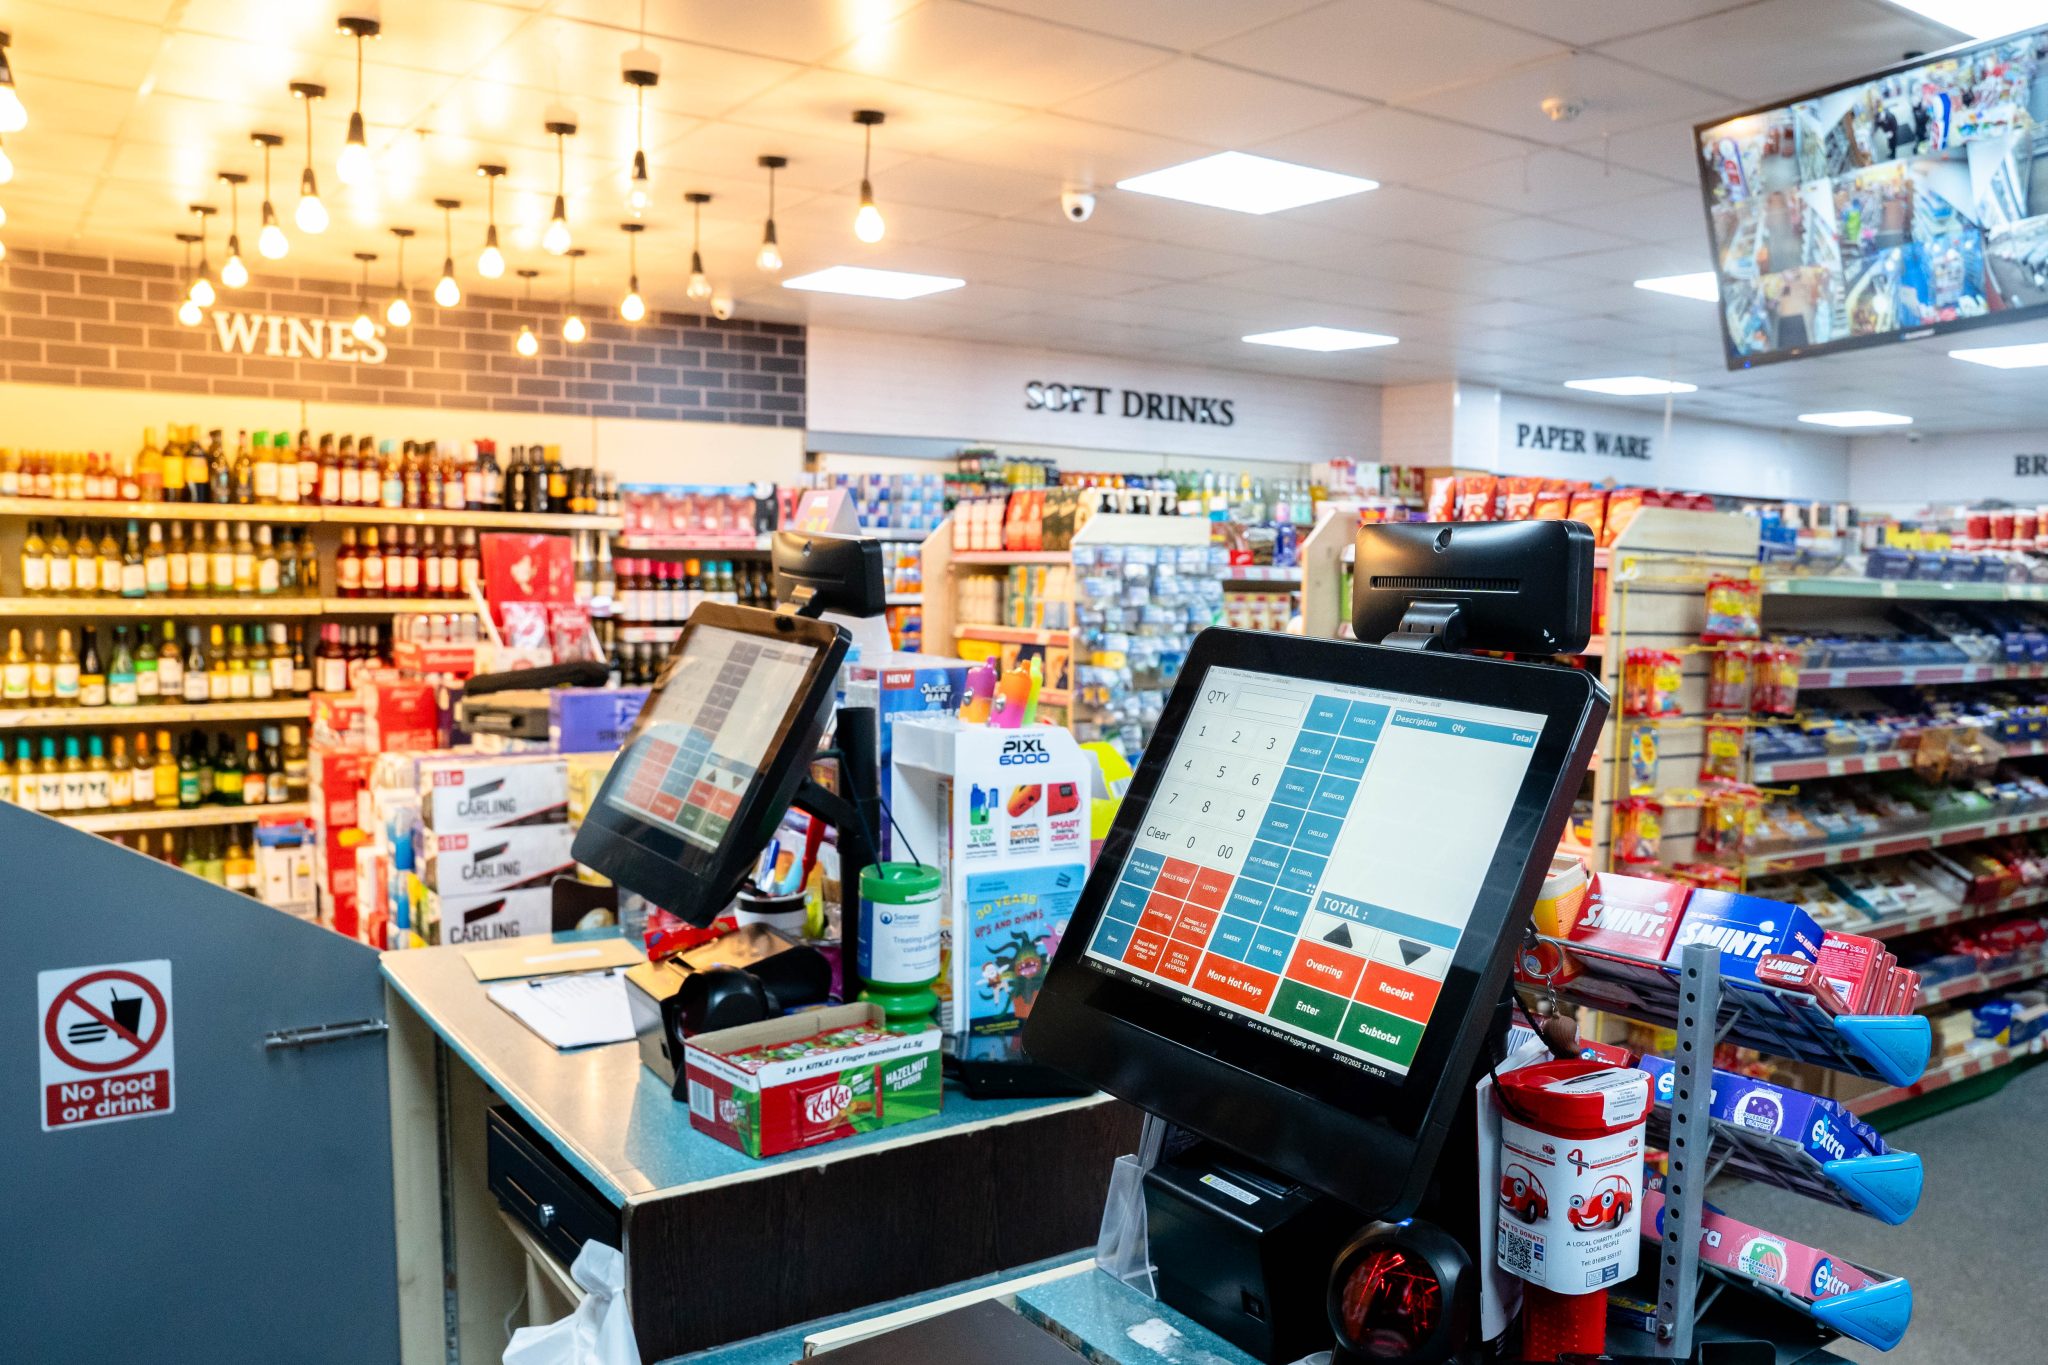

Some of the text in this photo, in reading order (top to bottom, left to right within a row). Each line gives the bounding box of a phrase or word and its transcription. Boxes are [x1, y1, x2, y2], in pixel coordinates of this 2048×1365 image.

[212, 311, 388, 364] WINES
[1025, 380, 1235, 427] SOFT DRINKS
[1516, 423, 1652, 460] PAPER WARE
[886, 674, 912, 684] NEW
[925, 693, 947, 702] BAR
[1207, 690, 1230, 703] QTY
[1353, 717, 1377, 726] TOBACCO
[1395, 715, 1533, 743] Description Qty Total
[1003, 739, 1046, 754] PIXL
[1199, 725, 1276, 750] 1 2 3
[1000, 753, 1050, 766] 6000
[1300, 746, 1365, 764] GROCERY HOUSEHOLD
[1184, 759, 1261, 786] 4 5 6
[1322, 791, 1345, 801] REDUCED
[457, 798, 516, 817] CARLING
[1169, 792, 1246, 822] 7 8 9
[970, 828, 993, 836] CLICK
[1010, 828, 1040, 839] BOOST
[1051, 820, 1081, 829] SMART
[1271, 820, 1329, 839] CRISPS CHILLED
[1010, 837, 1040, 846] SWITCH
[1051, 833, 1080, 841] DISPLAY
[1146, 826, 1171, 841] Clear
[1217, 844, 1234, 859] 00
[462, 861, 521, 881] CARLING
[1249, 856, 1280, 869] SOFT DRINKS
[1290, 866, 1313, 878] ALCOHOL
[1202, 884, 1218, 893] LOTTO
[995, 893, 1038, 908] YEARS
[1234, 893, 1299, 918] STATIONERY PAYPOINT
[1323, 897, 1359, 919] TOTAL
[450, 921, 520, 945] CARLING
[975, 924, 992, 938] UPS
[995, 919, 1012, 931] AND
[1223, 932, 1283, 957] BAKERY FRUIT VEG
[1794, 931, 1819, 958] 36 MINTS
[1171, 957, 1186, 967] LOTTO
[1172, 951, 1190, 961] HEALTH
[1164, 962, 1187, 975] PAYPOINT
[1207, 969, 1262, 998] More Hot Keys
[1306, 959, 1414, 1001] Overring Receipt
[1295, 1001, 1401, 1045] Enter Subtotal
[1247, 1021, 1256, 1029] Get
[1262, 1026, 1270, 1035] the
[1271, 1030, 1284, 1041] habit
[1284, 1034, 1290, 1042] of
[1290, 1037, 1306, 1049] logging
[1308, 1043, 1316, 1051] off
[786, 1067, 796, 1075] 24
[806, 1059, 833, 1071] KITKAT
[842, 1053, 865, 1064] Finger
[867, 1045, 901, 1058] Hazelnut
[903, 1040, 923, 1051] 41.5g
[1332, 1053, 1361, 1069] 13/02/2025
[885, 1056, 929, 1086] HAZELNUT
[61, 1073, 156, 1104] No food
[893, 1072, 923, 1092] FLAVOUR
[62, 1093, 156, 1121] or drink
[812, 1084, 850, 1122] KitKat
[1811, 1117, 1845, 1160] extra
[1649, 1178, 1663, 1190] NEW
[1519, 1229, 1544, 1244] DONATE
[1573, 1239, 1592, 1248] LOCAL
[1593, 1235, 1613, 1245] CHARITY,
[1615, 1227, 1632, 1238] HELPING
[1586, 1240, 1619, 1253] LOCAL PEOPLE
[1815, 1265, 1850, 1295] extra
